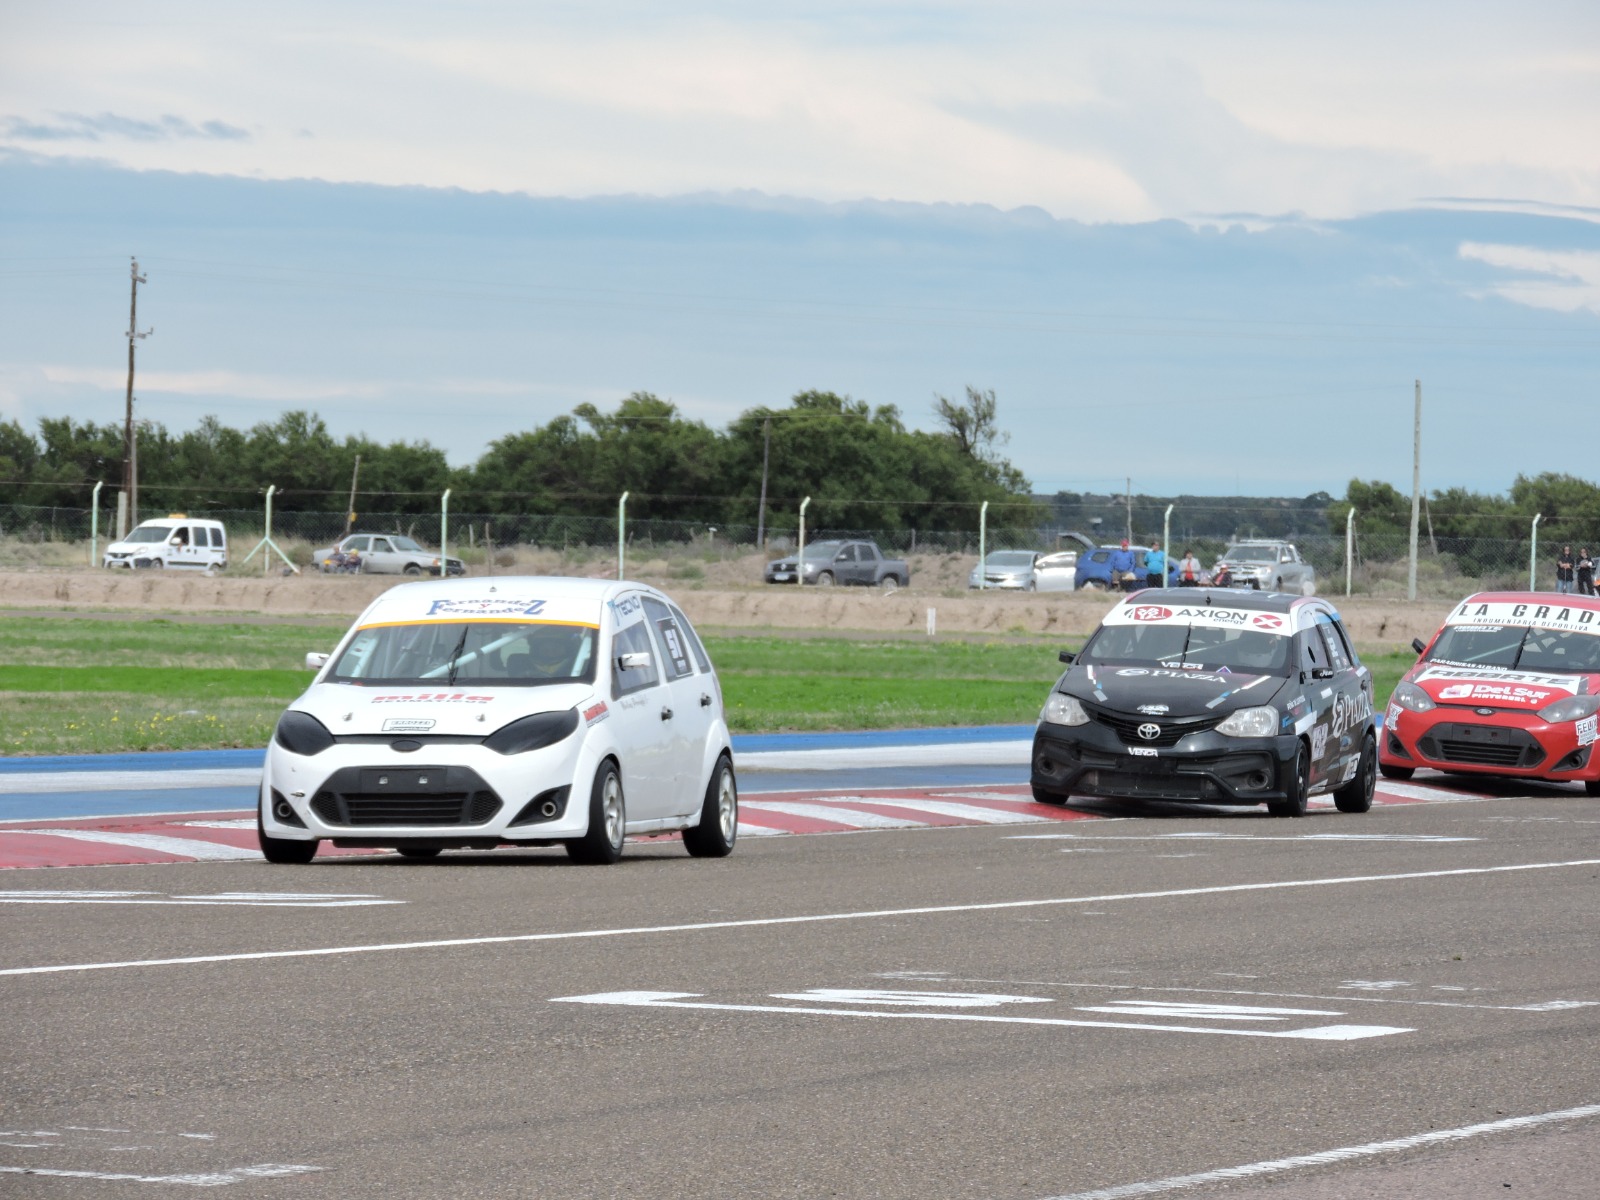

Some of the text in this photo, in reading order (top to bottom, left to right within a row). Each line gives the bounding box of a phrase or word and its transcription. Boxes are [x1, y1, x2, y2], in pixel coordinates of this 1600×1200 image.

[1176, 608, 1248, 621] AXION
[1458, 604, 1600, 626] LA GRAD
[1151, 670, 1227, 683] PIAZZA
